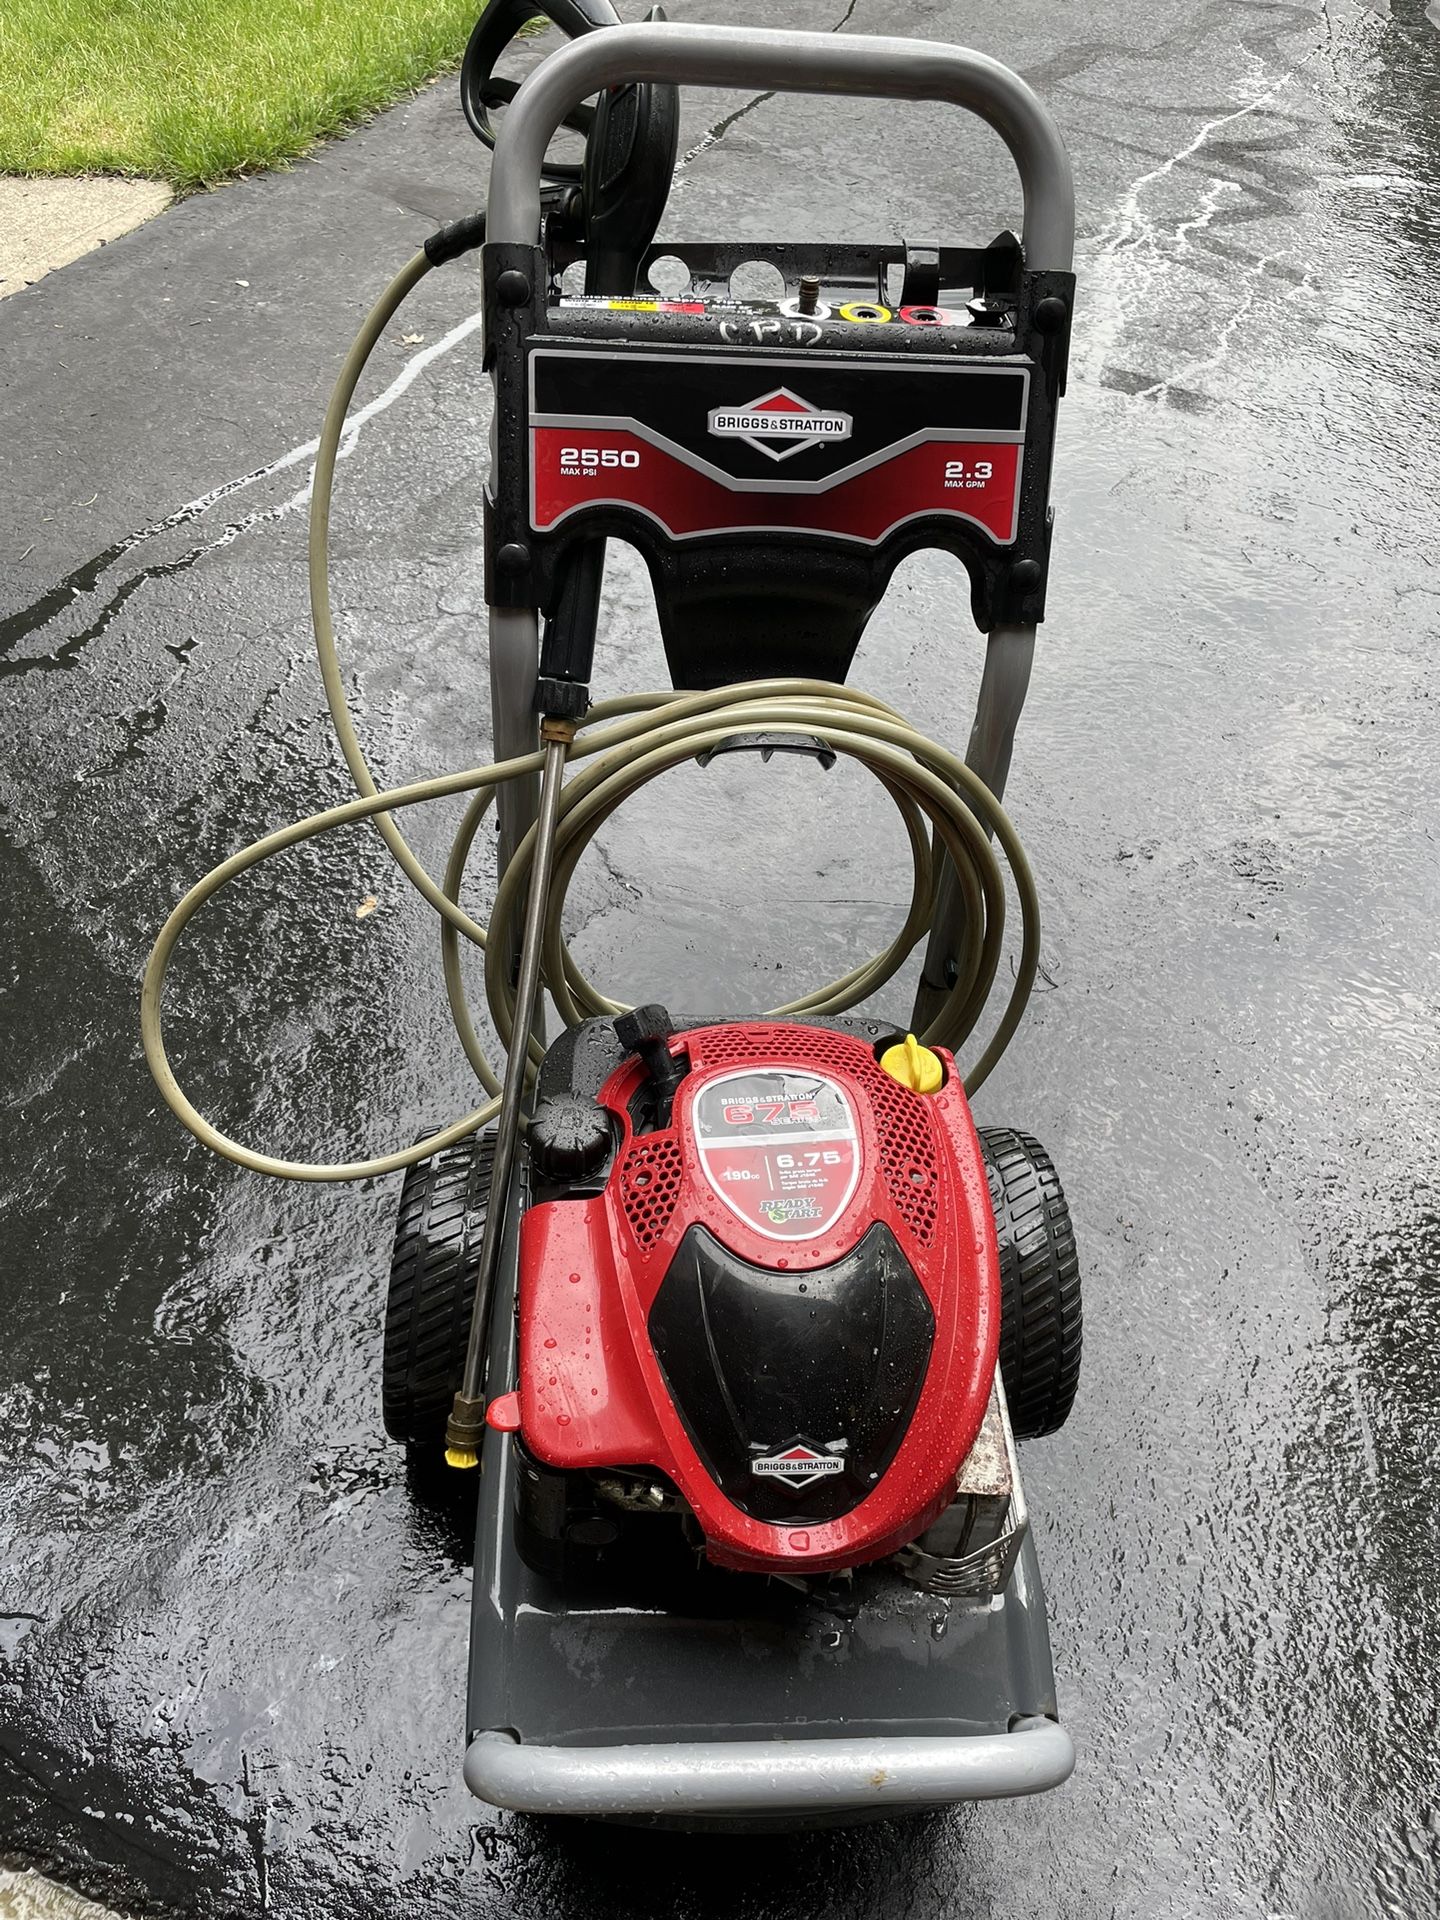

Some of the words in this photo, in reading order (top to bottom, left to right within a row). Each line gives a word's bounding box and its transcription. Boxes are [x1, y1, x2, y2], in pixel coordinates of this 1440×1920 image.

[560, 447, 640, 468] 2550
[560, 467, 581, 476] MAX
[582, 468, 597, 476] PSI
[945, 461, 993, 479] 2.3
[944, 480, 964, 488] MAX
[965, 480, 986, 489] GPM
[723, 1100, 820, 1125] 675
[776, 1150, 841, 1168] 6.75
[759, 1197, 816, 1213] READY
[772, 1206, 823, 1221] START
